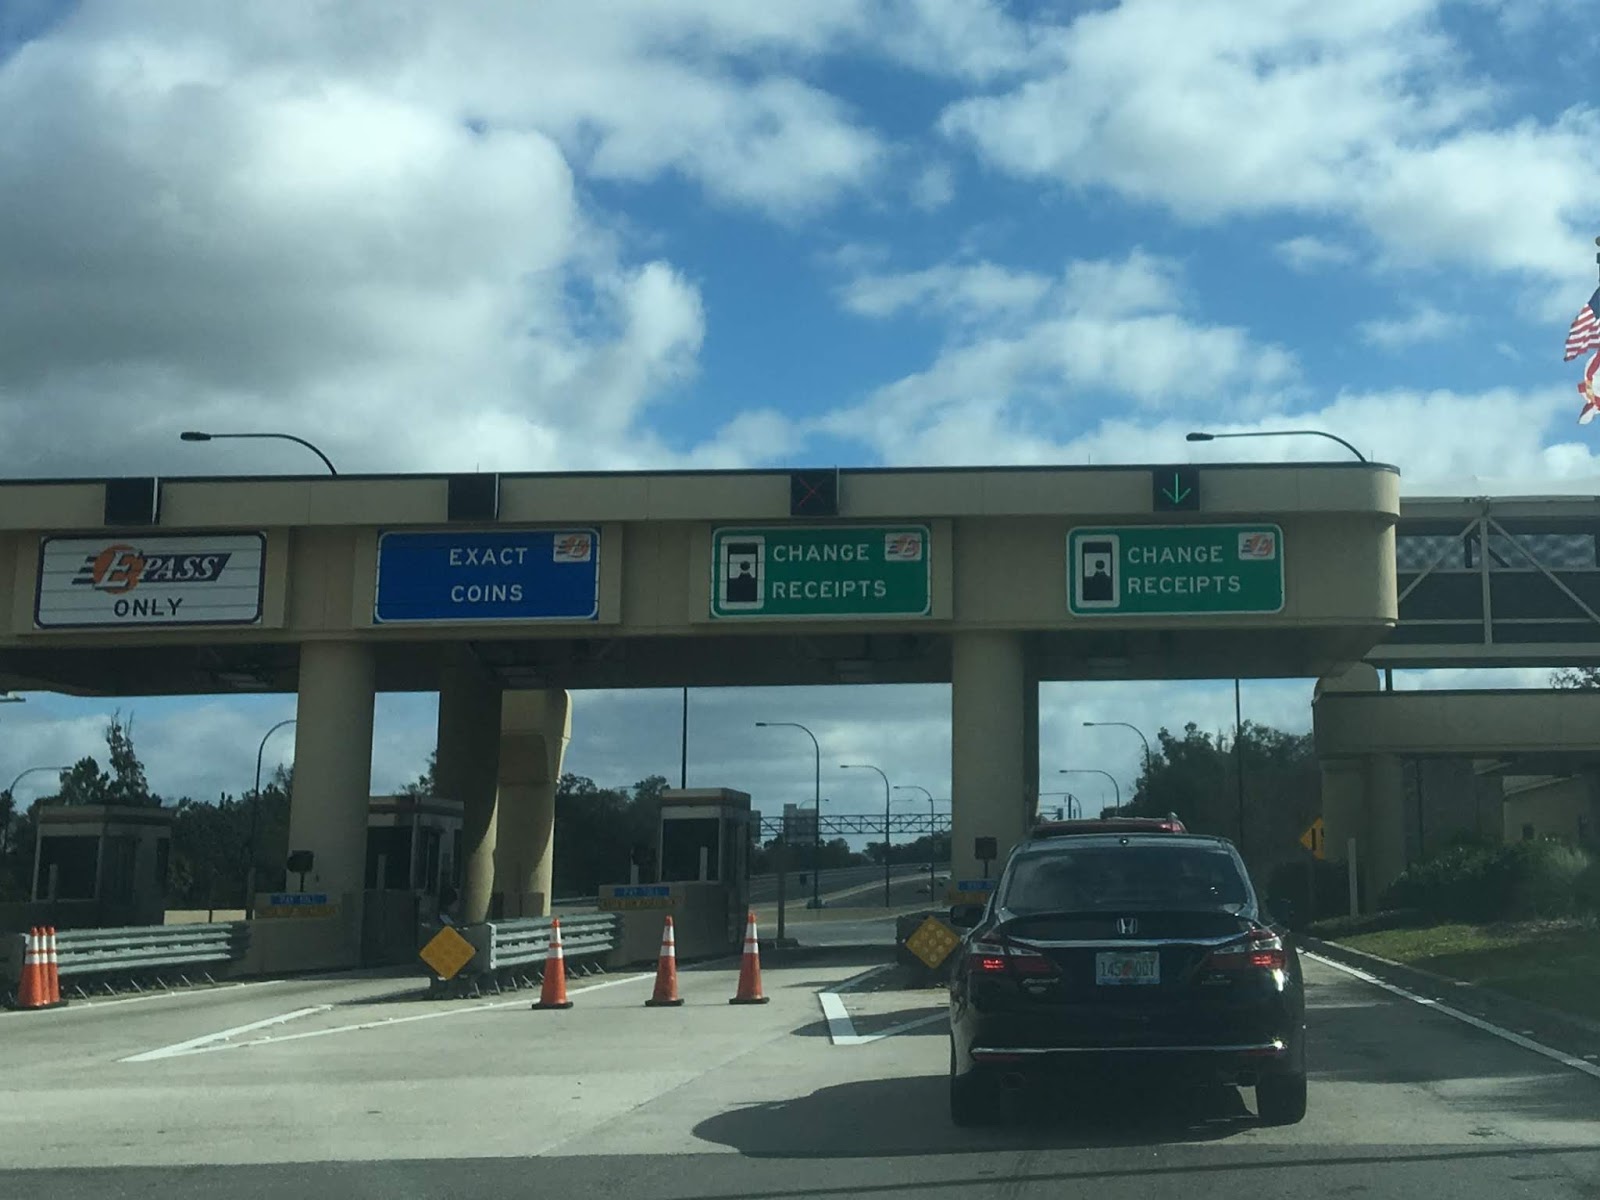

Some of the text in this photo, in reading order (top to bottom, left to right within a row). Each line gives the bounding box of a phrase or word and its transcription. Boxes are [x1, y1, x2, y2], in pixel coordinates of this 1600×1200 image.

[449, 547, 528, 566] EXACT
[773, 544, 870, 562] CHANGE
[1127, 545, 1224, 564] CHANGE
[451, 584, 523, 602] COINS
[772, 580, 887, 599] RECEIPTS
[1127, 576, 1241, 594] RECEIPTS
[114, 598, 183, 617] ONLY
